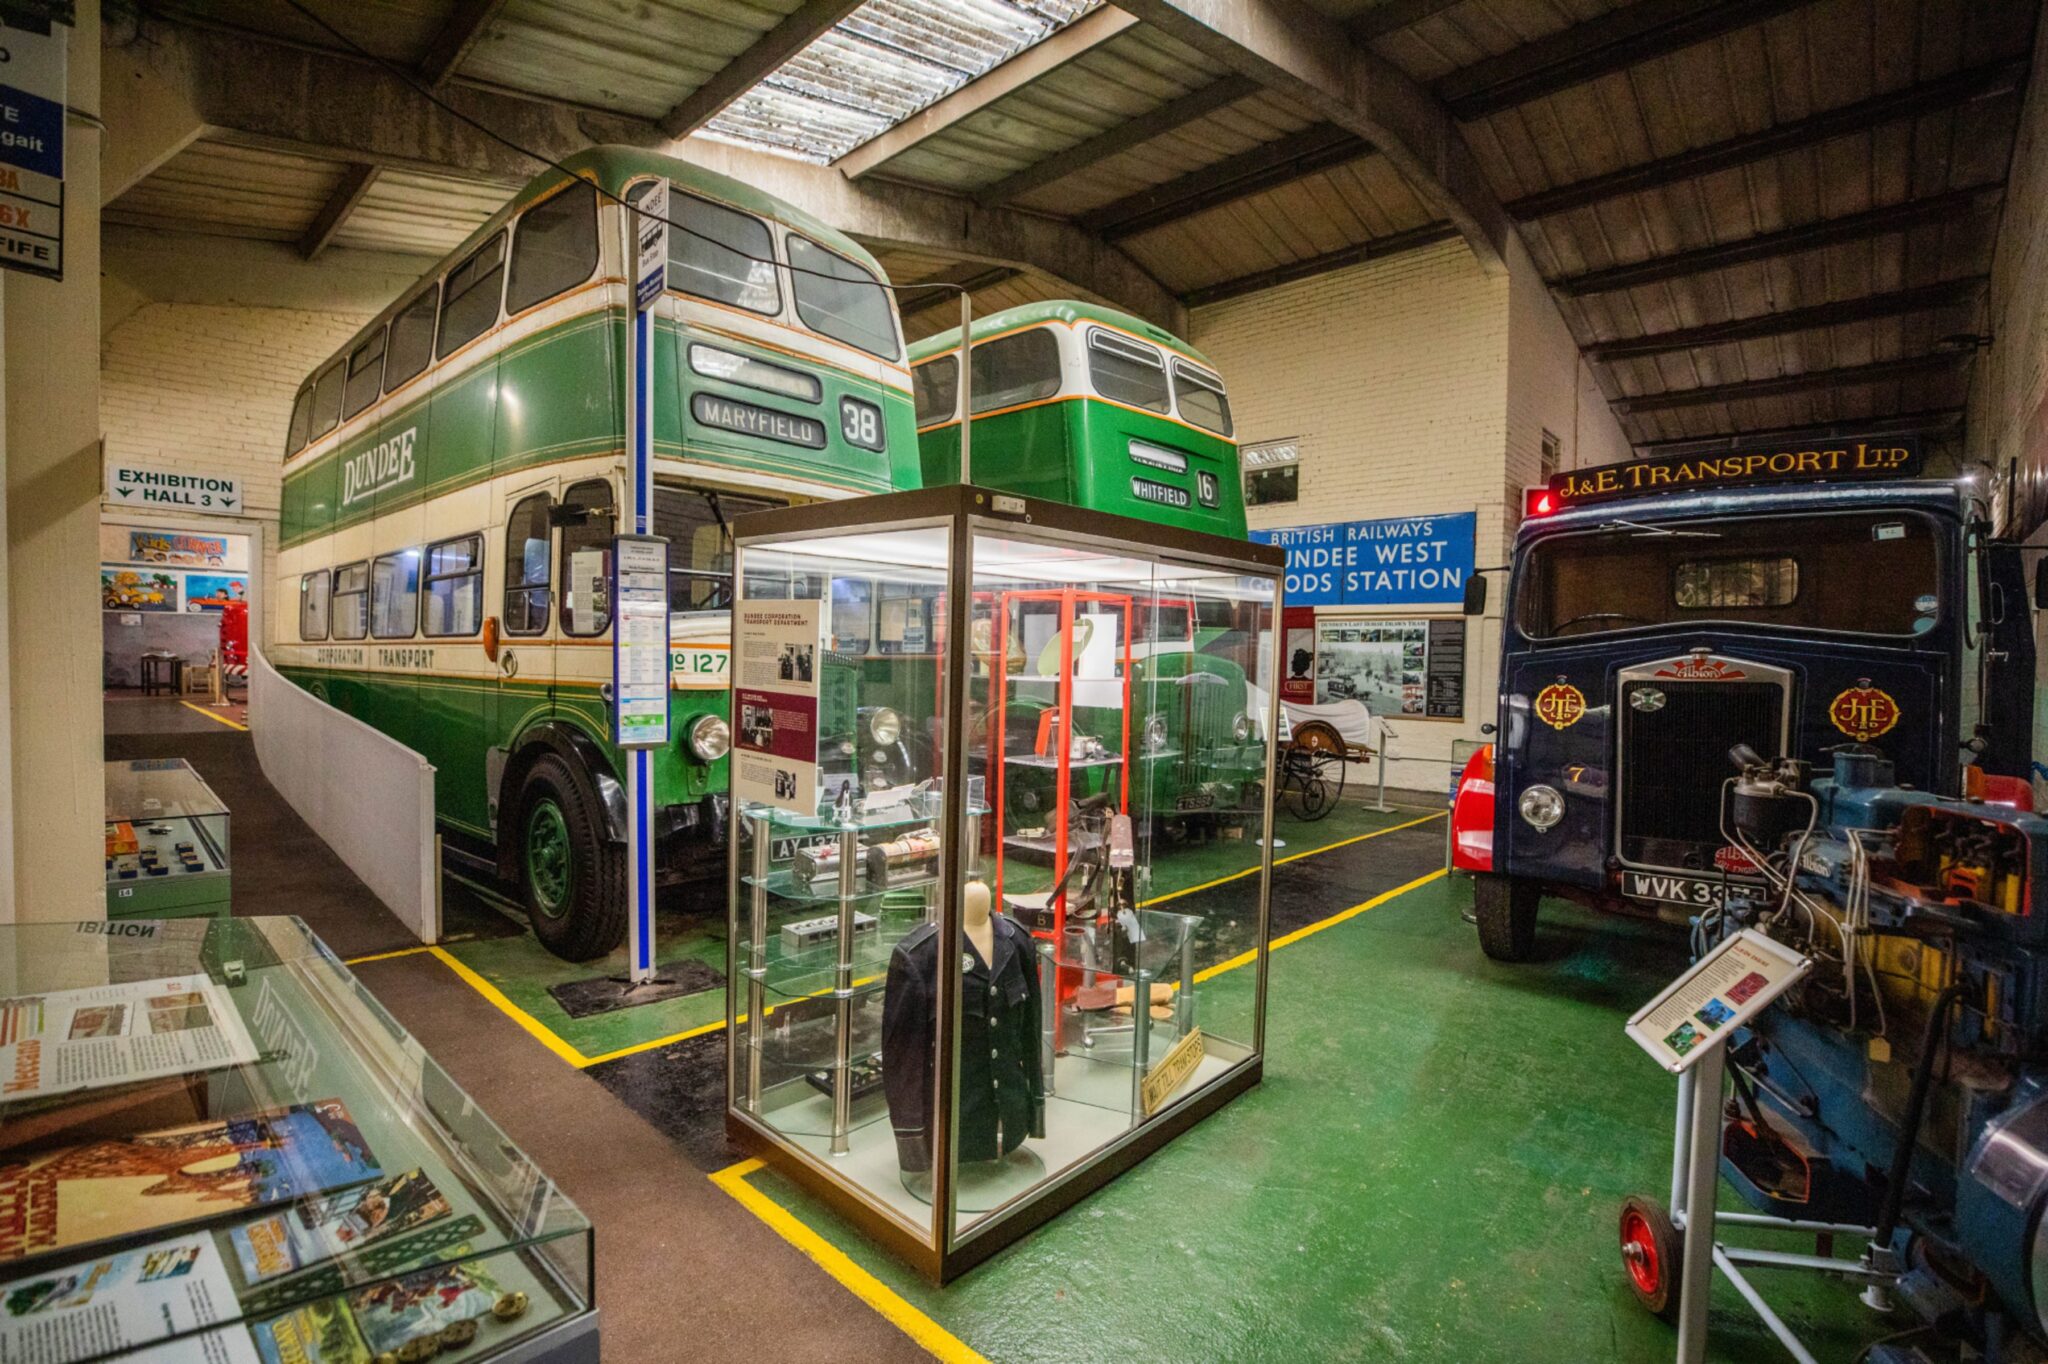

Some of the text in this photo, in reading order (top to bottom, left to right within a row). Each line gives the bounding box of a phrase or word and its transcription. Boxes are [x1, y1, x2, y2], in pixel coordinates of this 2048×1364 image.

[704, 400, 812, 442] MARYFIELD
[843, 403, 876, 444] 38
[343, 427, 416, 506] DUNDEE
[1622, 450, 1848, 487] TRANSPORT
[118, 468, 234, 492] EXHIBITION
[1198, 474, 1213, 500] 16
[143, 489, 212, 507] HALL 3
[1132, 479, 1187, 506] WHITFIELD
[1271, 522, 1433, 546] BRITISH RAILWAYS
[1375, 541, 1448, 565] WEST
[1347, 568, 1462, 592] STATION
[764, 612, 801, 620] CORPORATION
[773, 619, 808, 627] DEPARTMENT
[318, 648, 363, 665] CORPORATION
[379, 648, 434, 669] TRANSPORT
[694, 653, 728, 673] 127
[1677, 665, 1721, 679] Albion
[1569, 766, 1584, 783] 7
[119, 889, 132, 897] 14
[1634, 874, 1687, 901] WVK
[1038, 914, 1046, 926] B
